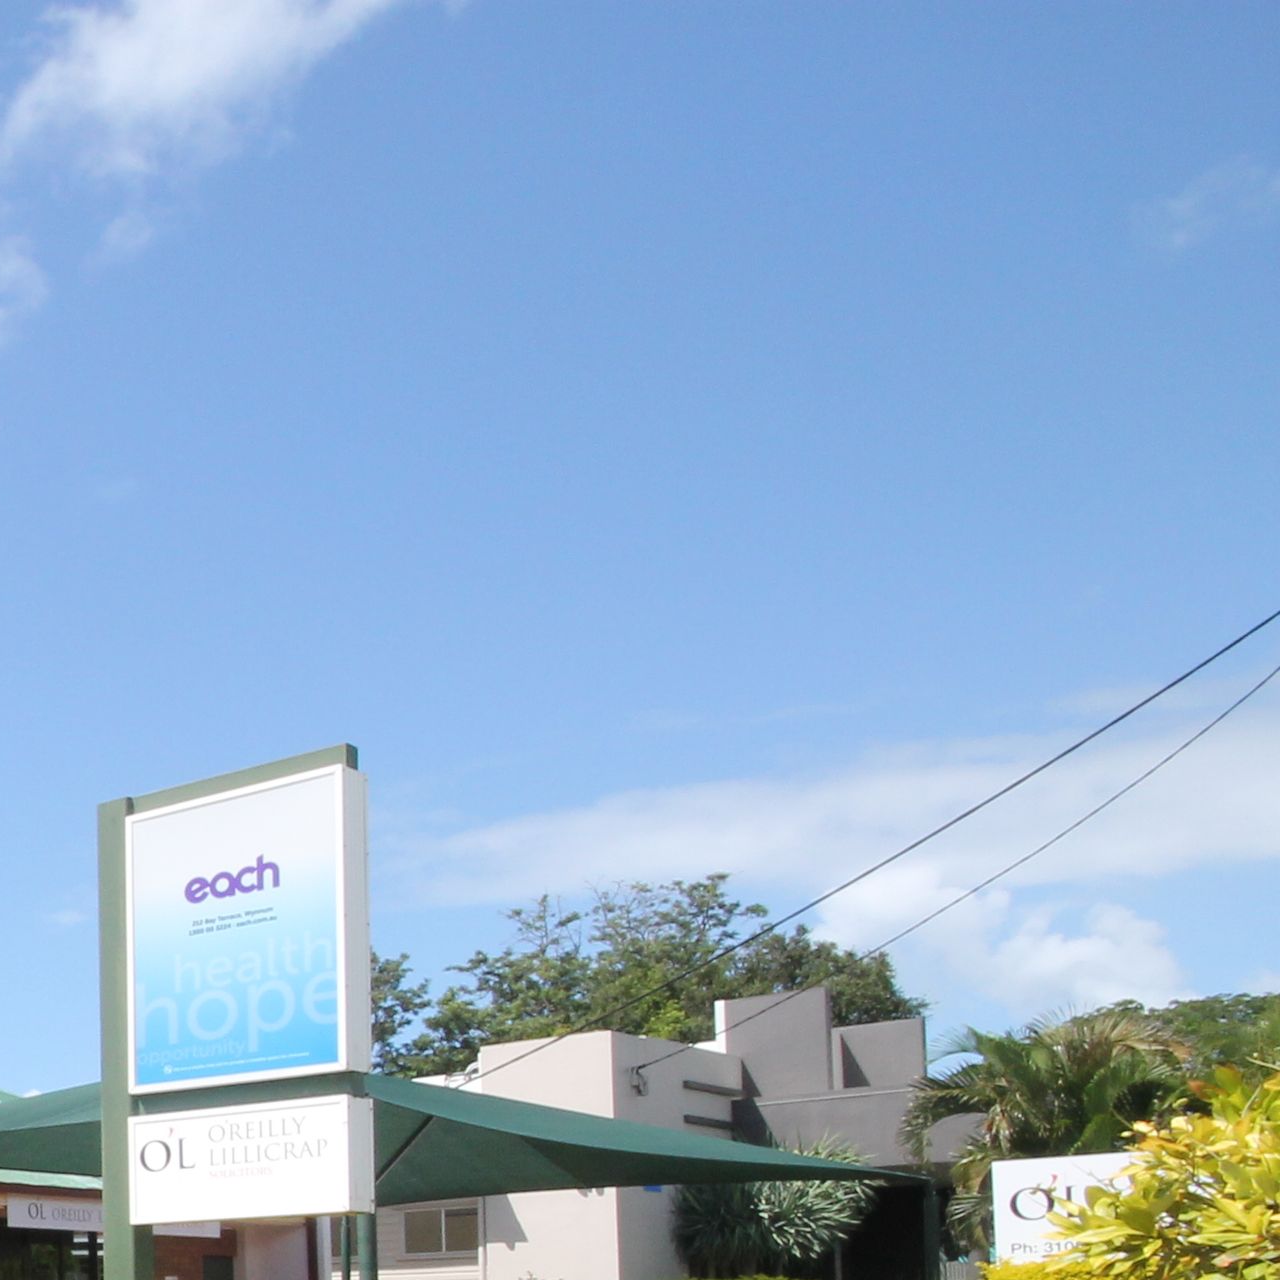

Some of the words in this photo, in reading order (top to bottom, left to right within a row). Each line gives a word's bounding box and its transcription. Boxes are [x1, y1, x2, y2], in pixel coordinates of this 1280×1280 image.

[184, 853, 280, 904] each
[175, 931, 334, 993] health
[136, 970, 338, 1053] hope
[137, 1038, 247, 1067] opportunity
[208, 1115, 307, 1144] O'REILLY
[208, 1138, 329, 1167] LILLICRAP
[1010, 1241, 1038, 1255] Ph:
